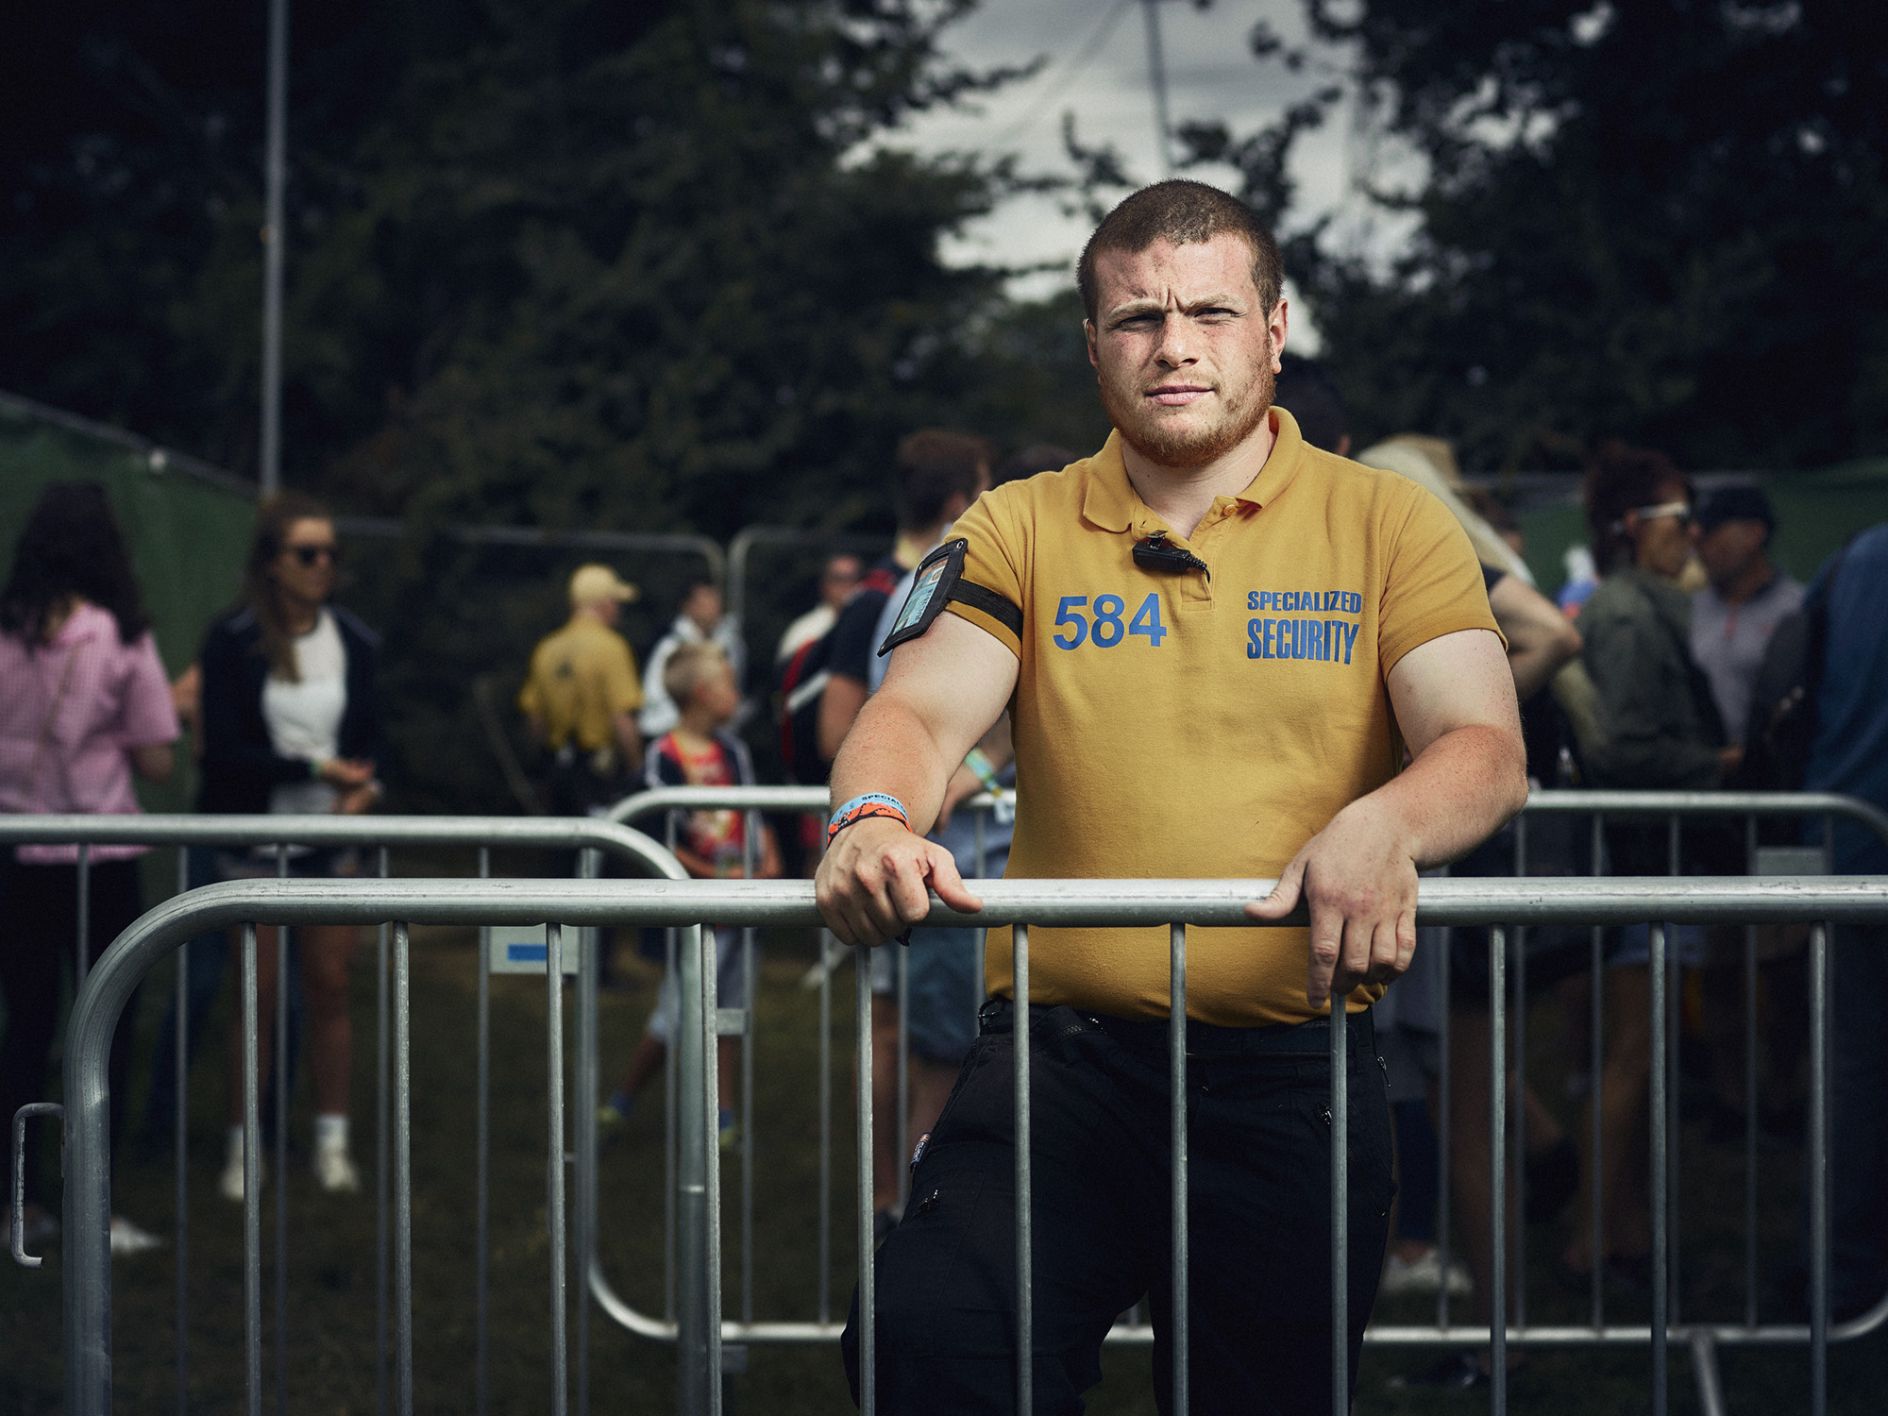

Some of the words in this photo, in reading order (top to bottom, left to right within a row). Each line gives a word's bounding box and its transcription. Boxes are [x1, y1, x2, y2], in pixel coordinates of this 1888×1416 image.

[1053, 592, 1167, 650] 584
[1247, 591, 1362, 614] SPECIALIZED
[1247, 618, 1360, 665] SECURITY
